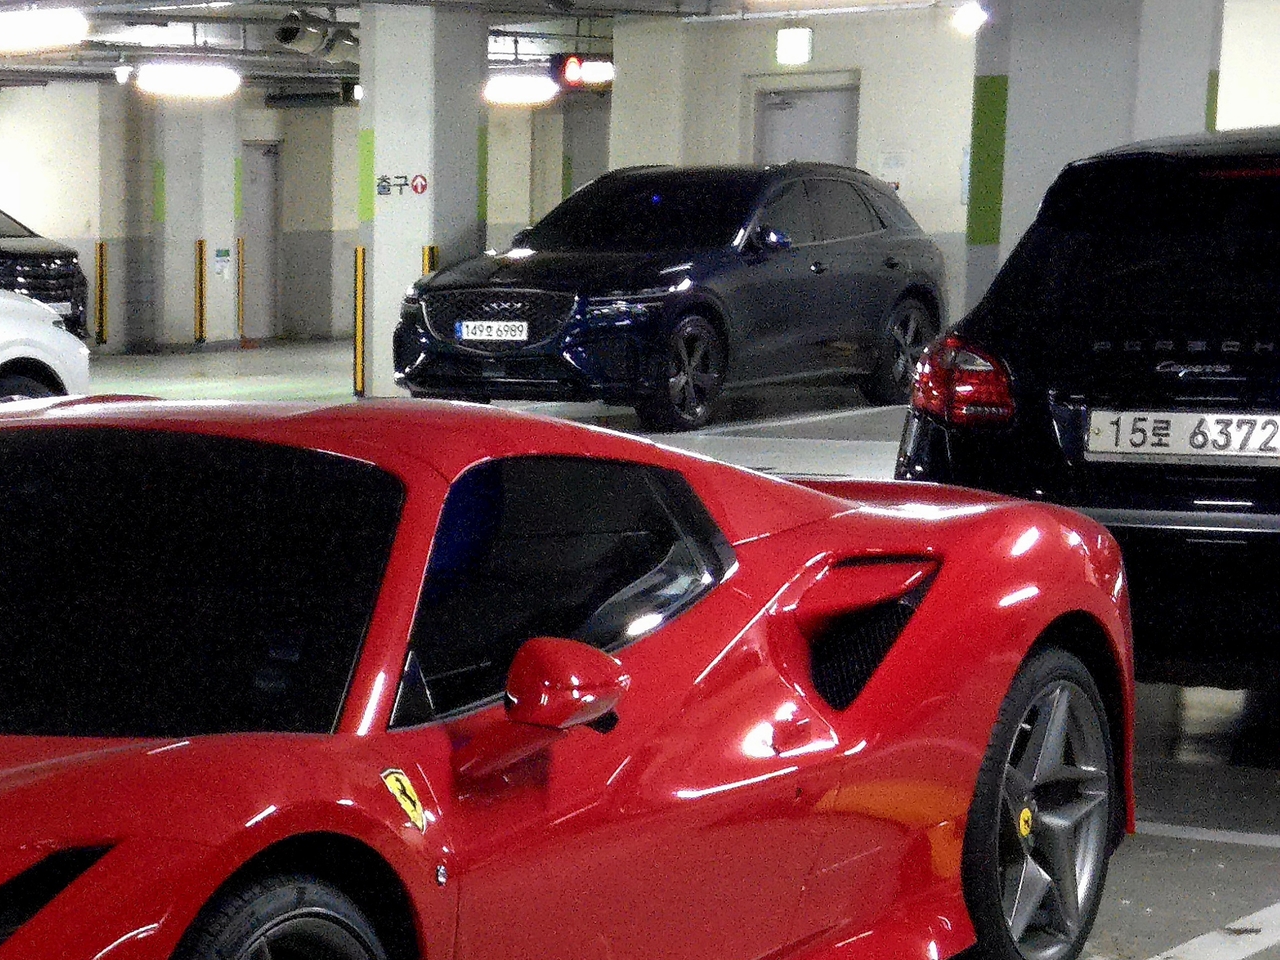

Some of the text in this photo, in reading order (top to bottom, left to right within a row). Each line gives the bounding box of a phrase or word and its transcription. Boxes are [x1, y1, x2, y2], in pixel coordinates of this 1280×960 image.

[376, 174, 409, 195] 출구
[1093, 340, 1274, 352] PORSCH
[1108, 415, 1280, 451] 15로 6372
